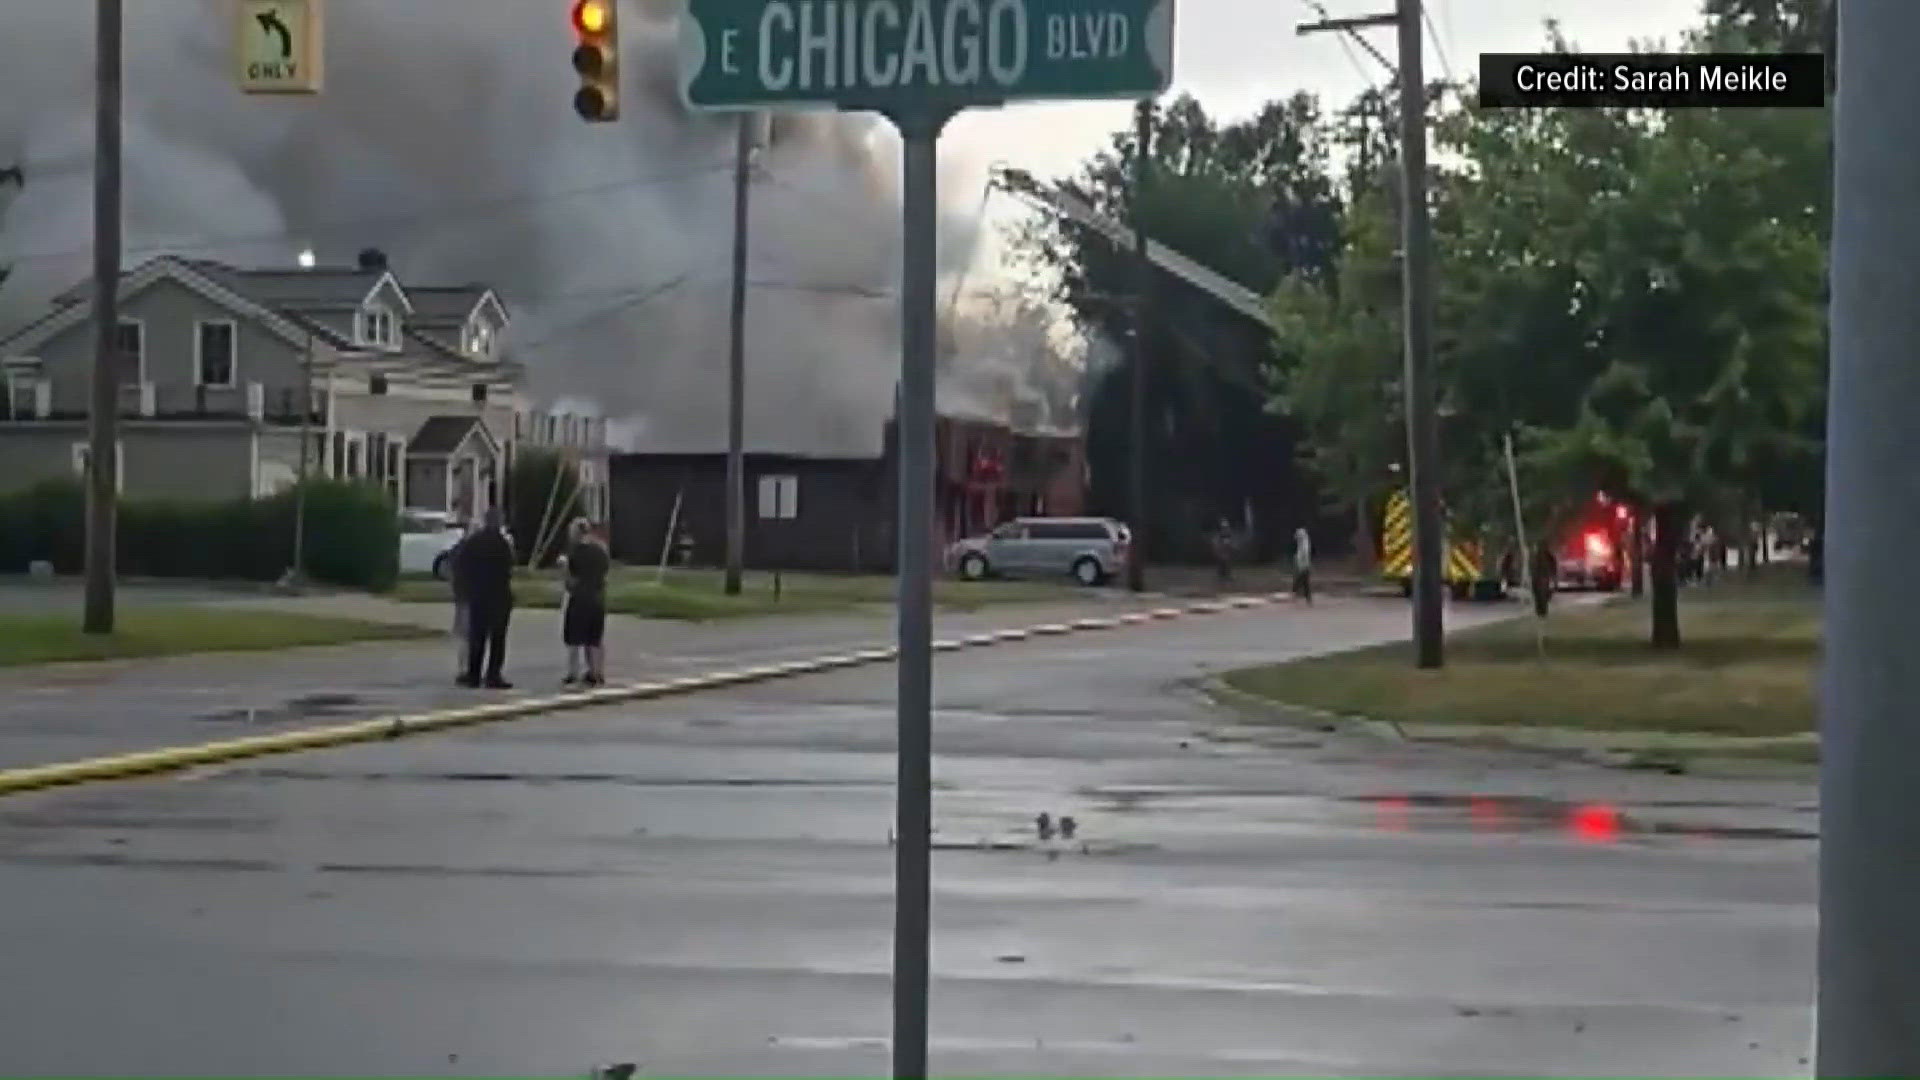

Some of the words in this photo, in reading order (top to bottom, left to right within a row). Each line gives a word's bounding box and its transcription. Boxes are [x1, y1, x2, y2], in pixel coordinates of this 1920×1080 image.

[721, 29, 740, 73] E
[758, 0, 1029, 91] CHICAGO
[1046, 13, 1128, 60] BLVD
